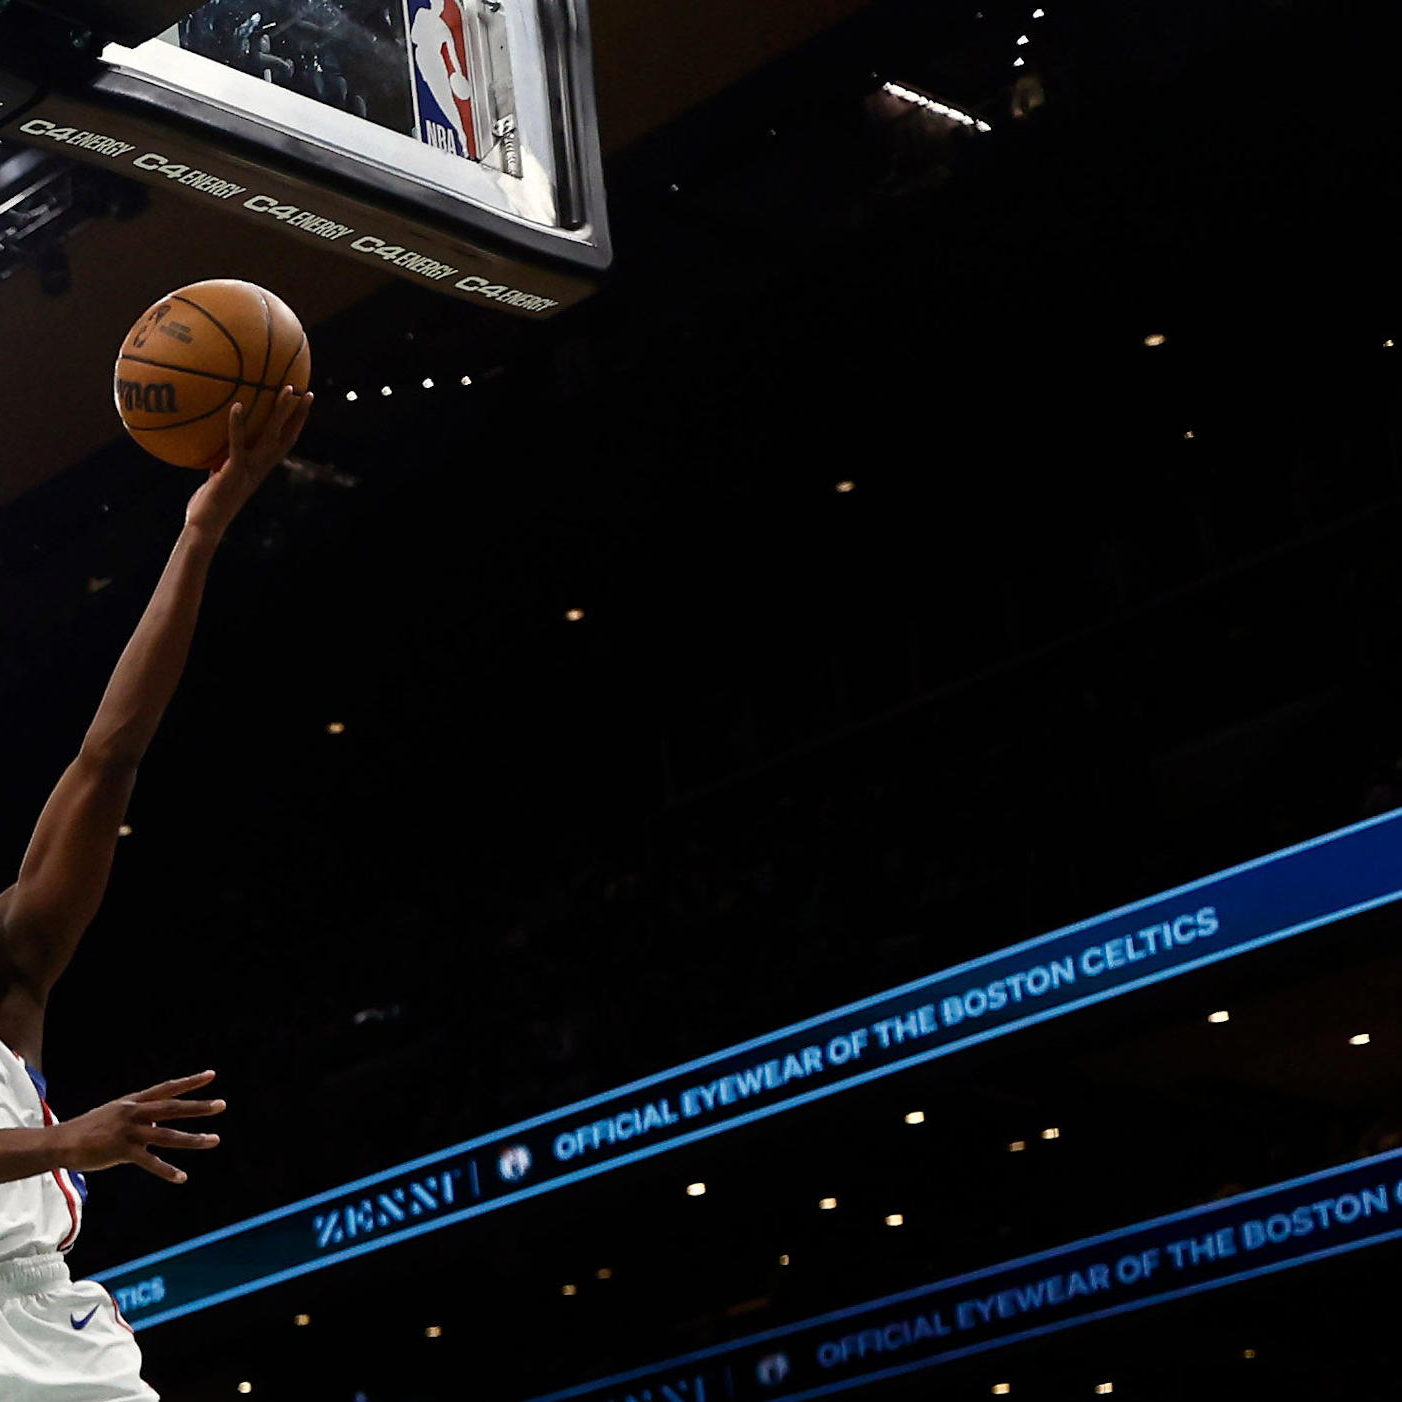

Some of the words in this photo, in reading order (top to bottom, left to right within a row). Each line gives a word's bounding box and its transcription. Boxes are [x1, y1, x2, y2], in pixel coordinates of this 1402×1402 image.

[19, 119, 76, 143] C4
[66, 130, 137, 159] ENERGY
[132, 152, 190, 179] C4
[177, 169, 246, 200] ENERGY
[243, 194, 303, 221] C4
[290, 211, 354, 242] ENERGY
[350, 235, 406, 262] C4
[393, 251, 458, 282] ENERGY
[454, 275, 510, 299] C4
[496, 289, 559, 312] ENERGY
[312, 1169, 464, 1249] ZENNI
[553, 1098, 679, 1161] OFFICIAL
[680, 1046, 824, 1120] EYEWEAR
[826, 1026, 869, 1067] OF
[873, 1001, 938, 1050] THE
[940, 953, 1075, 1027] BOSTON
[1078, 904, 1220, 978] CELTICS
[117, 1276, 165, 1313] TICS
[816, 1312, 950, 1369] OFFICIAL
[956, 1263, 1112, 1332] EYEWEAR
[1115, 1247, 1160, 1286] OF
[1165, 1225, 1236, 1271] THE
[1240, 1183, 1389, 1253] BOSTON
